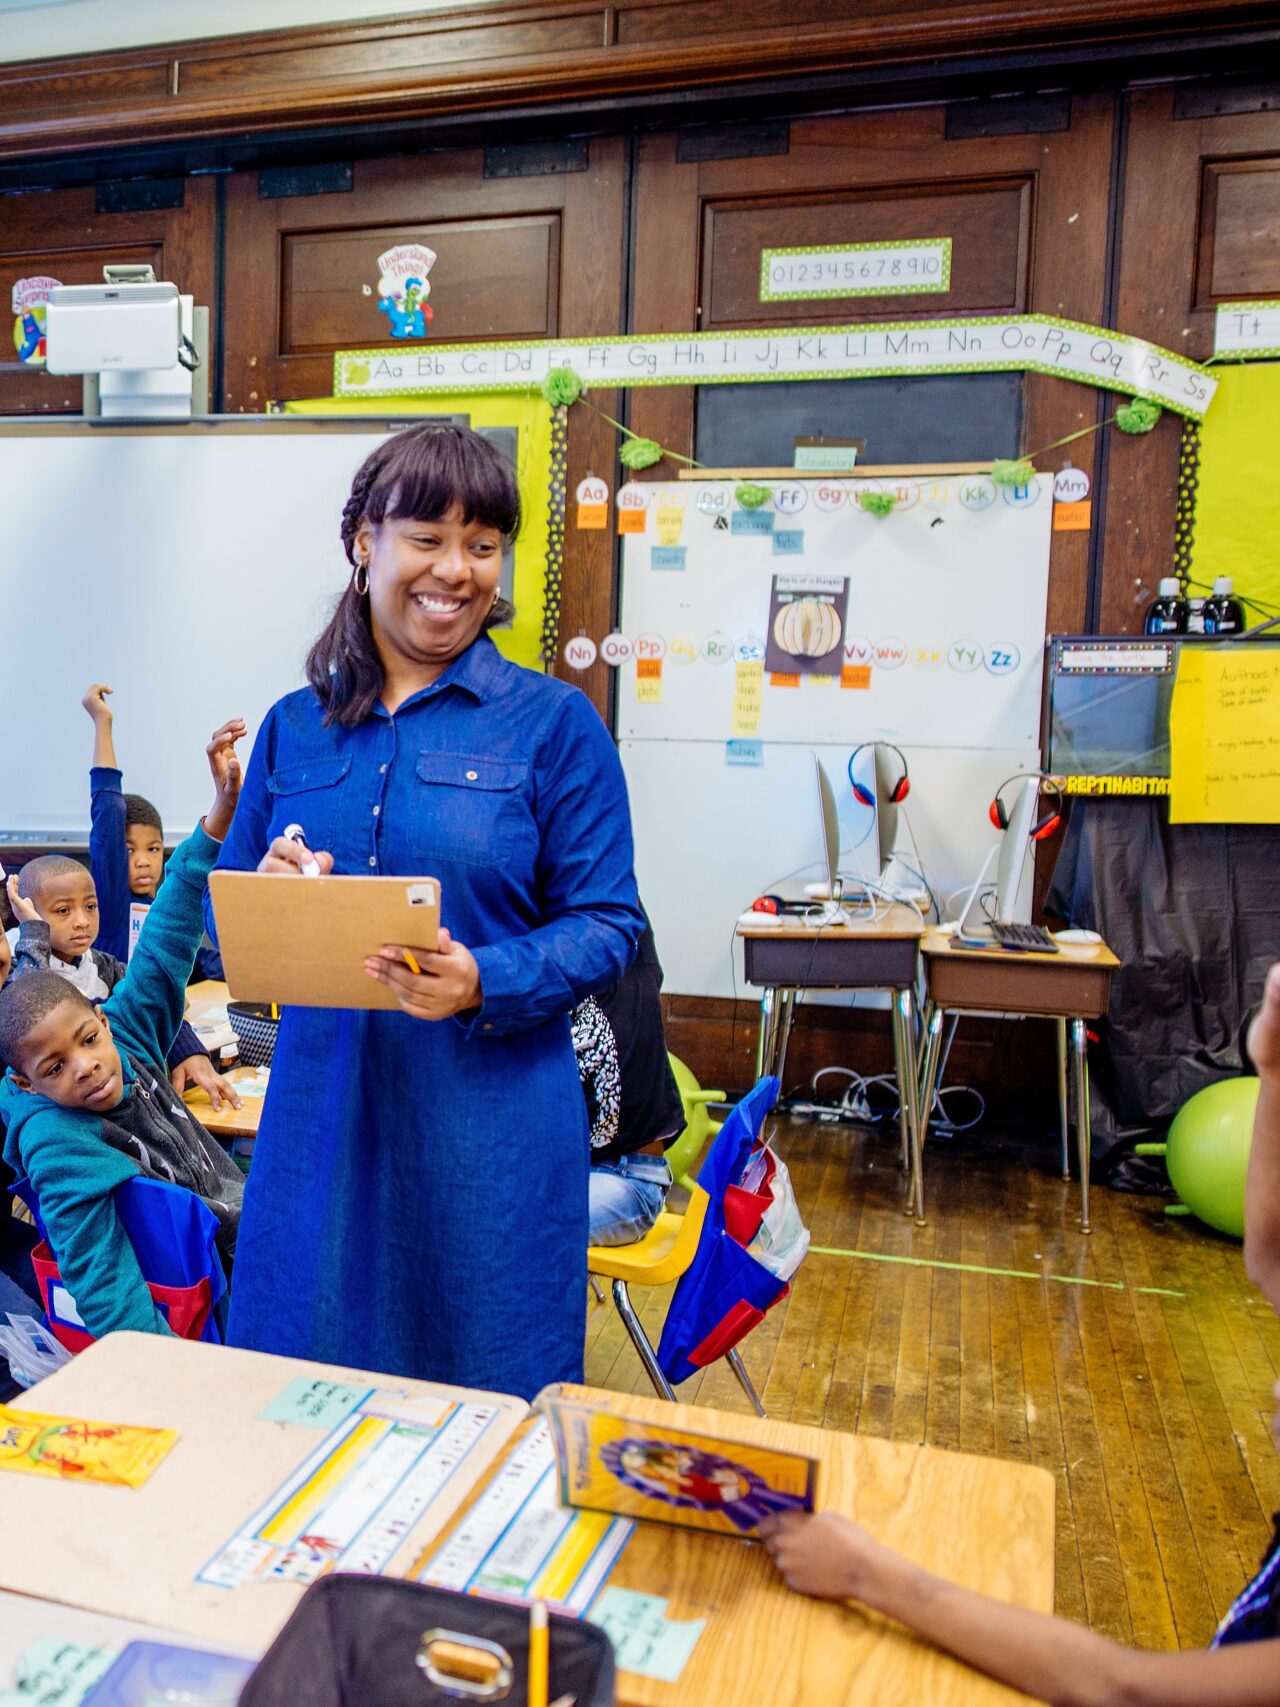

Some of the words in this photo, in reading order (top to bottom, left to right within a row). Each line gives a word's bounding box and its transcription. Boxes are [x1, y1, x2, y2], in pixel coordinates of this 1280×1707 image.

[1232, 313, 1261, 336] Tt
[375, 359, 403, 379] Aa
[417, 355, 445, 377] Bb
[461, 353, 488, 375] Cc
[504, 351, 532, 372] Dd
[588, 346, 612, 368] Ff
[628, 344, 657, 374] Gg
[674, 342, 705, 365] Hh
[722, 341, 737, 363] Ii
[755, 340, 780, 370] Jj
[797, 337, 828, 360] Kk
[845, 335, 868, 358] Ll
[885, 333, 930, 355] Mm
[948, 330, 982, 353] Nn
[1001, 326, 1036, 350] Oo
[1042, 328, 1072, 363] Pp
[1090, 341, 1123, 375] Qq
[1139, 353, 1170, 384] Rr
[1183, 374, 1207, 401] Ss
[582, 486, 603, 501] Aa
[622, 492, 644, 507] Bb
[779, 489, 800, 506] Ff
[819, 487, 841, 504] Gg
[966, 485, 989, 502] Kk
[1054, 479, 1088, 495] Mm
[570, 647, 592, 661] Nn
[606, 642, 629, 657] Oo
[639, 640, 661, 657] Pp
[845, 644, 867, 659] Vv
[877, 647, 903, 660] Ww
[954, 646, 977, 664] Yy
[991, 650, 1012, 667] Zz
